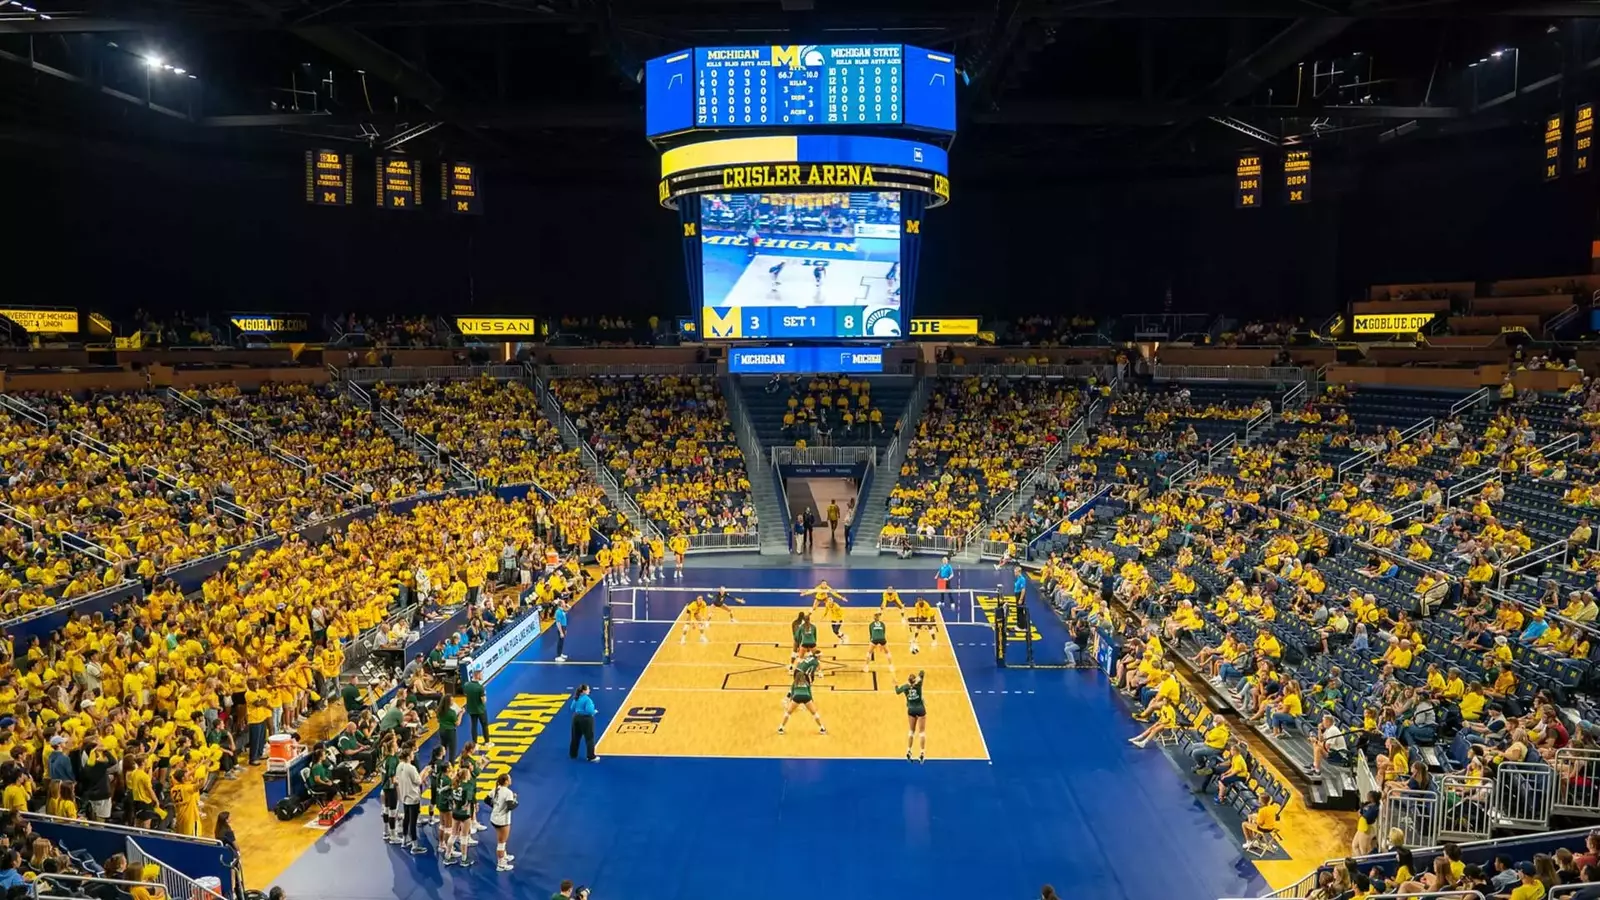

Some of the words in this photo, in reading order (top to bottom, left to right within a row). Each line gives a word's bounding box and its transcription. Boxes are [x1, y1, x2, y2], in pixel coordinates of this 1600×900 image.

[708, 50, 759, 59] MICHIGAN
[831, 49, 870, 57] MICHIGAN
[874, 48, 899, 57] STATE
[1240, 158, 1260, 166] NIT
[723, 166, 800, 188] CRISLER
[808, 165, 876, 186] ARENA
[324, 192, 336, 202] M
[1242, 194, 1254, 204] M
[1290, 190, 1302, 200] M
[394, 196, 406, 206] M
[457, 202, 468, 212] M
[684, 222, 696, 236] M
[906, 220, 920, 234] M
[462, 322, 530, 331] NISSAN
[704, 307, 742, 338] M
[750, 316, 760, 329] 3
[783, 316, 804, 326] SET
[810, 316, 816, 327] 1
[844, 316, 854, 328] 8
[741, 354, 785, 364] MICHIGAN
